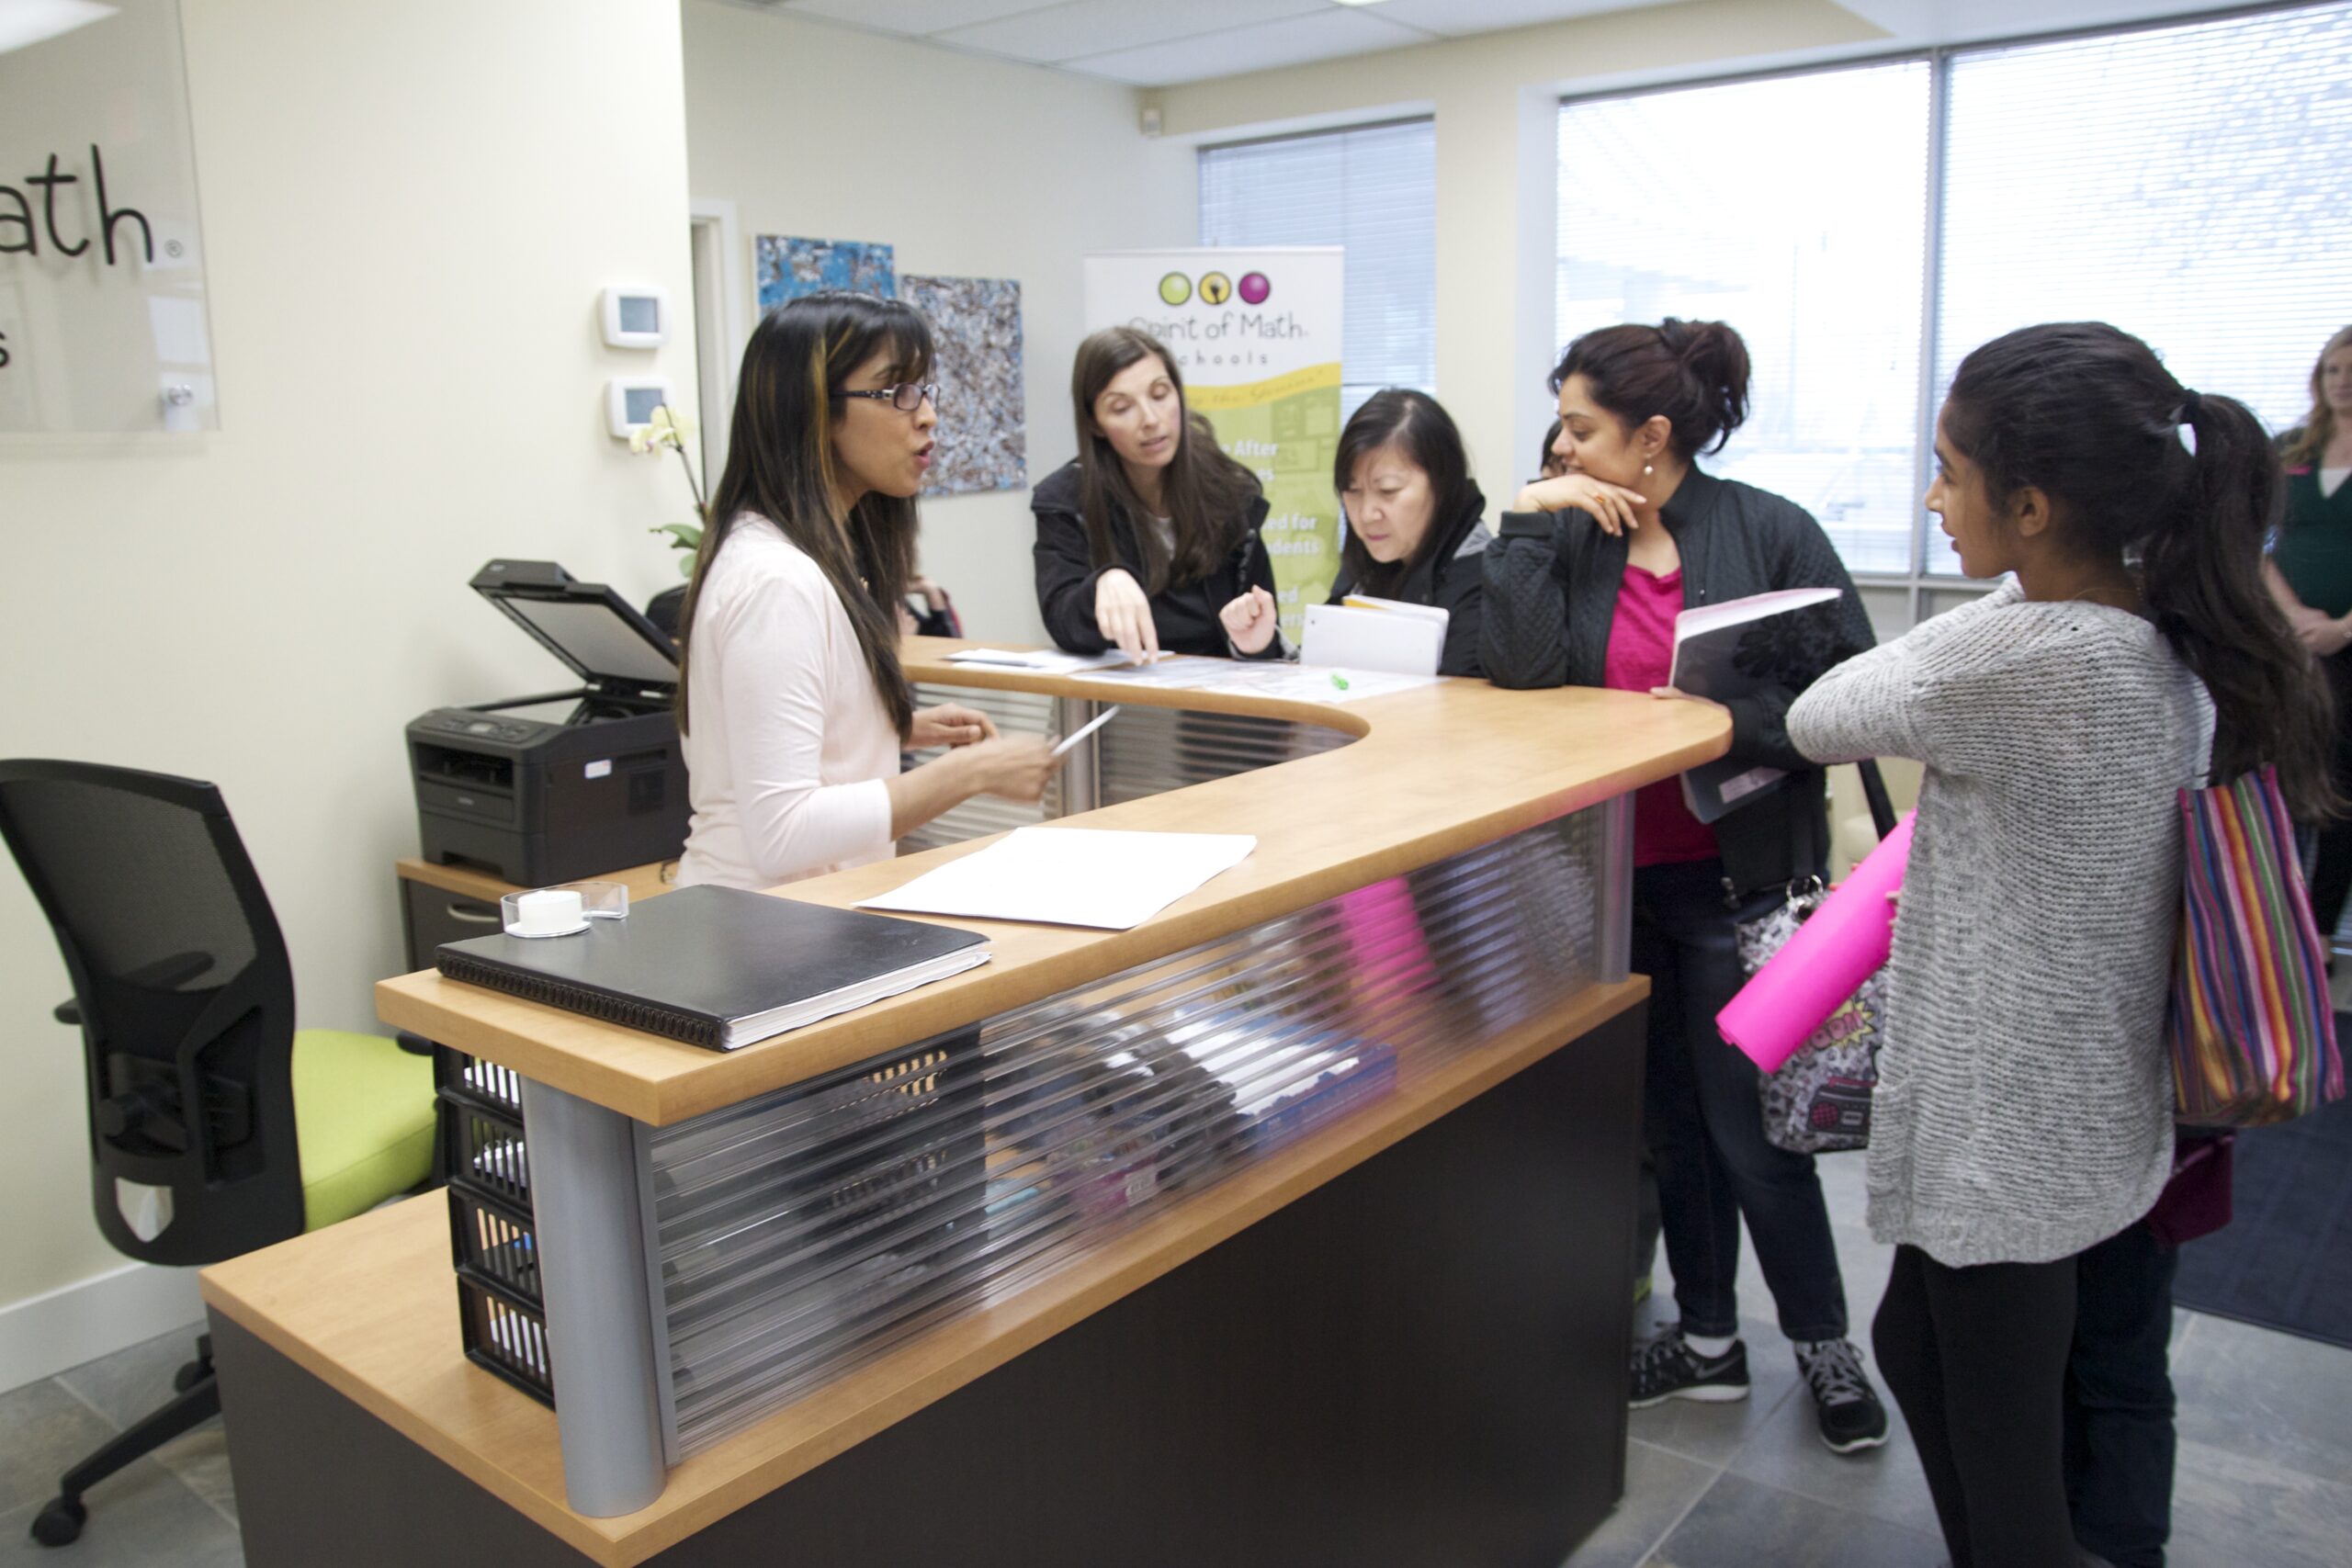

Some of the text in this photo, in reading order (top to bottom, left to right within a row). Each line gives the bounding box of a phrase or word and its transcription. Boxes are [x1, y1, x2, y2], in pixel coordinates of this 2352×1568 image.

[0, 143, 153, 265] ath
[1204, 310, 1235, 339] of
[1239, 310, 1304, 339] Math
[1177, 349, 1268, 367] chools
[1234, 440, 1279, 457] After
[1291, 513, 1317, 530] for
[1268, 538, 1320, 554] dents
